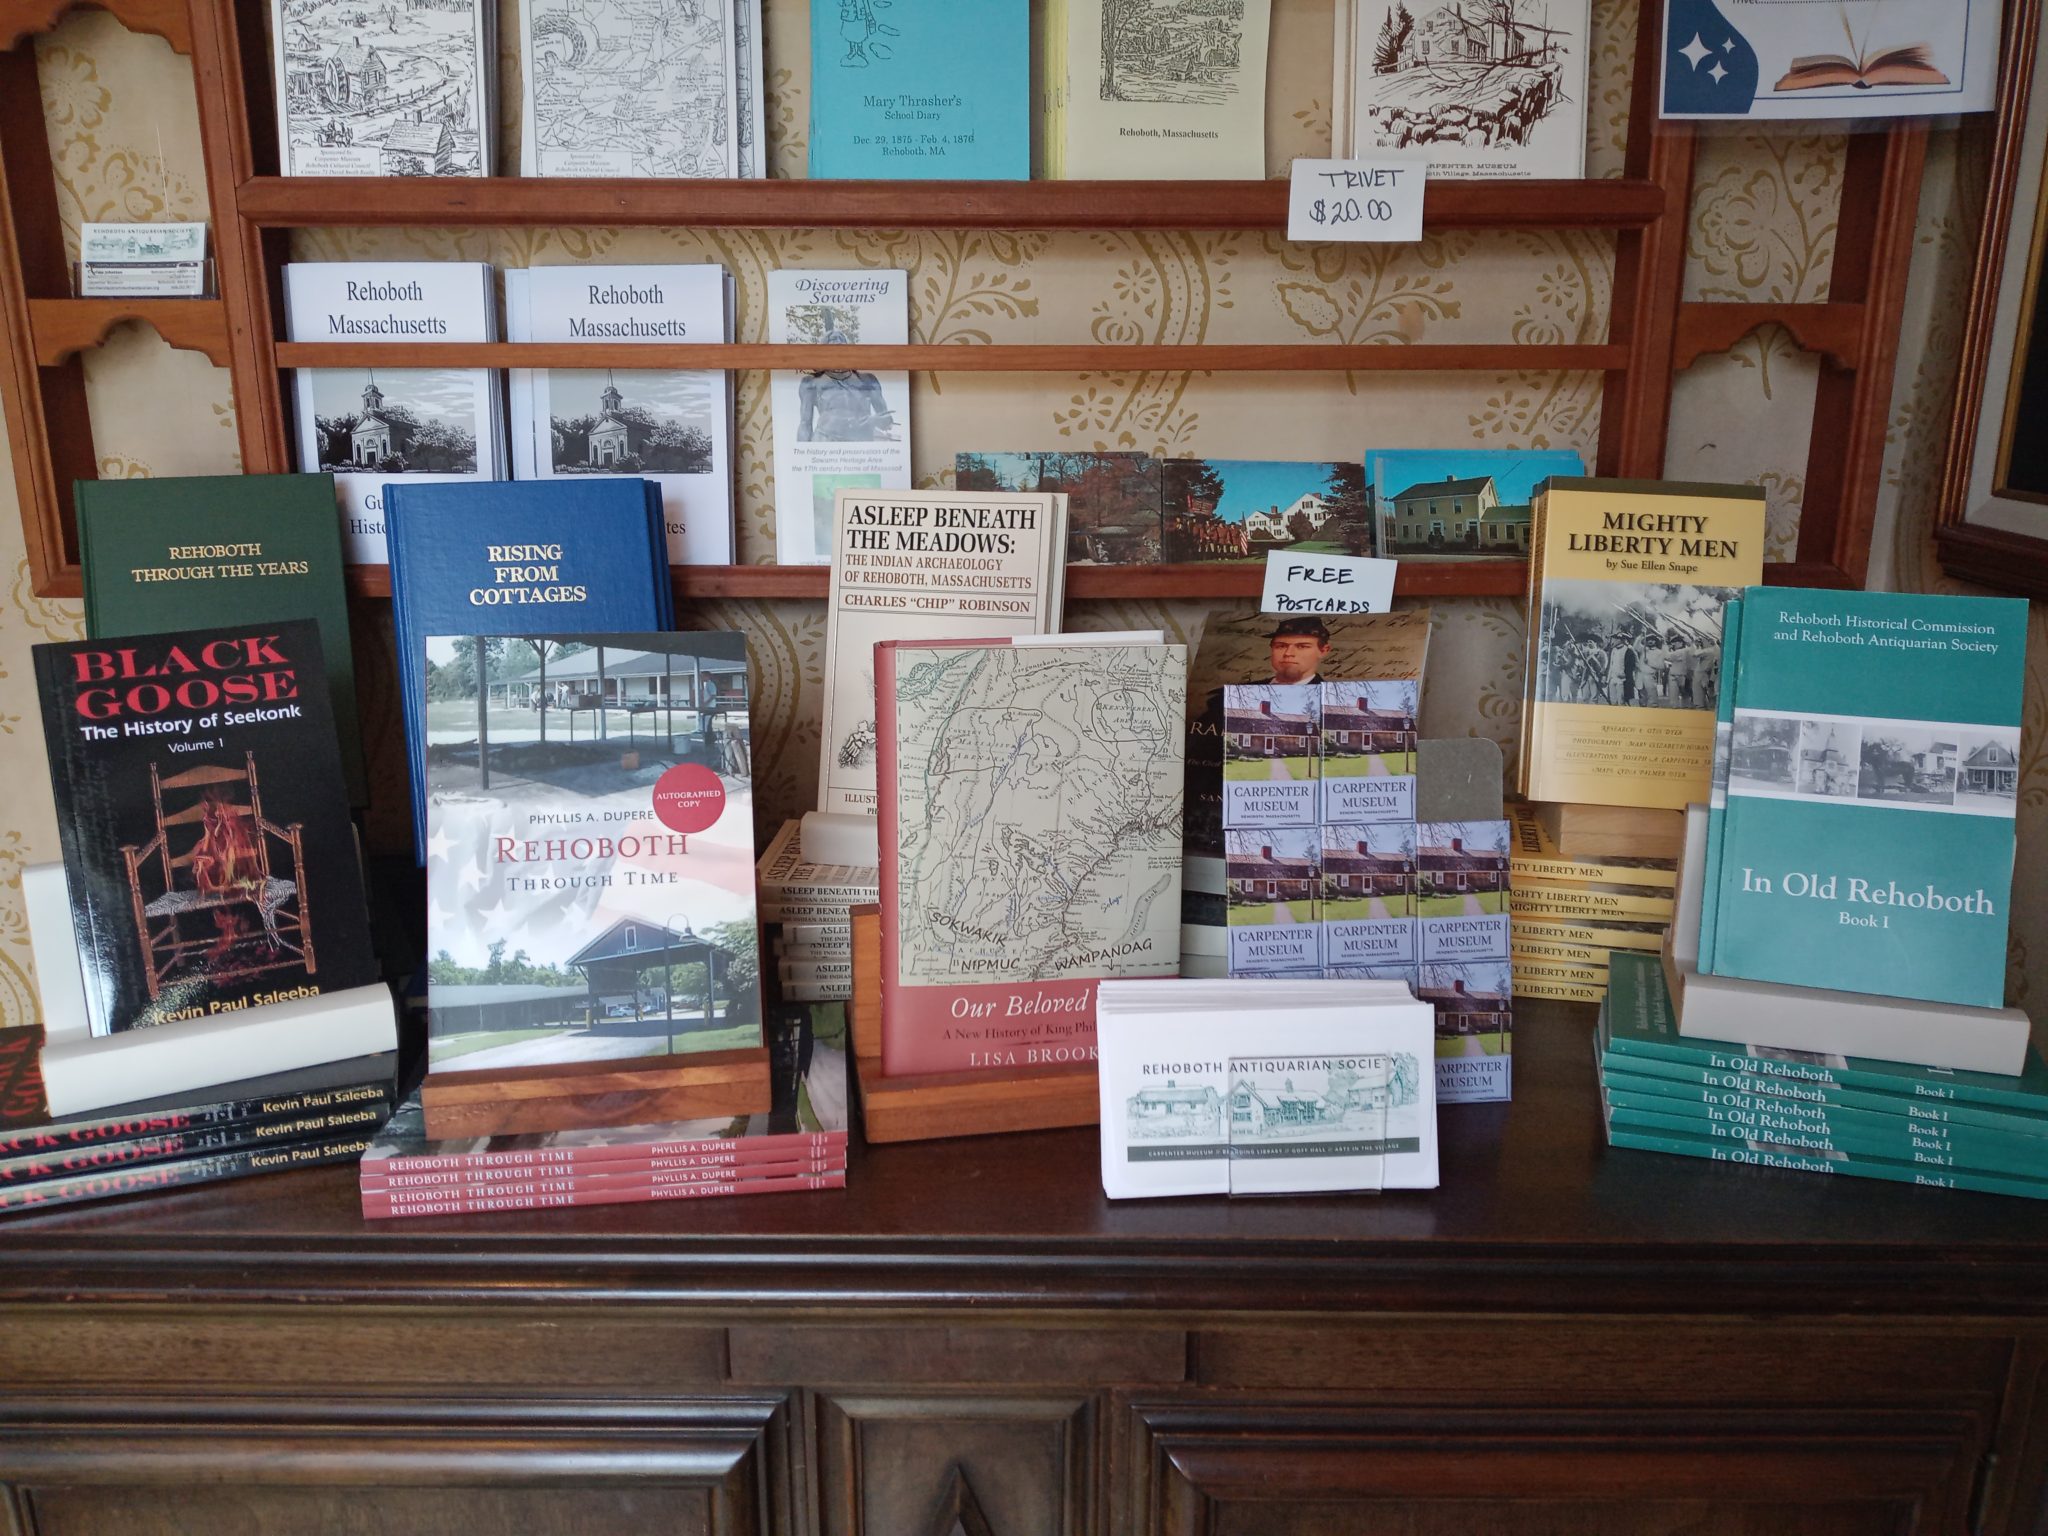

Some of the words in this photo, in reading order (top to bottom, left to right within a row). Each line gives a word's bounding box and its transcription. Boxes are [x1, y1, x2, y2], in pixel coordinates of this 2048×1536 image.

[864, 95, 895, 109] Mary
[899, 94, 962, 106] Thrasher's
[885, 111, 914, 120] School
[917, 111, 941, 120] Diary
[1120, 128, 1160, 138] Rehoboth,
[1162, 129, 1218, 138] Massachusetts
[882, 147, 926, 156] Rehoboth,
[930, 147, 945, 155] MA
[1319, 168, 1404, 188] TRIVET
[1309, 199, 1393, 225] $20.00
[347, 281, 423, 300] Rehoboth
[589, 284, 664, 304] Rehoboth
[795, 278, 889, 294] Discovering
[810, 292, 876, 304] Sowams
[328, 314, 446, 334] Massachusetts
[568, 317, 685, 336] Massachusetts
[848, 506, 928, 527] ASLEEP
[934, 508, 1037, 530] BENEATH
[1603, 512, 1708, 533] MIGHTY
[169, 543, 261, 560] REHOBOTH
[847, 530, 890, 550] THE
[896, 532, 1015, 554] MEADOWS:
[1568, 534, 1671, 555] LIBERTY
[1680, 538, 1738, 558] MEN
[487, 544, 563, 562] RISING
[846, 554, 868, 566] THE
[871, 555, 912, 568] INDIAN
[916, 557, 1003, 570] ARCHAEOLOGY
[132, 565, 214, 582] THROUGH
[218, 564, 253, 578] THE
[257, 561, 308, 576] YEARS
[494, 566, 559, 583] FROM
[1288, 566, 1354, 584] FREE
[1607, 558, 1617, 569] by
[1621, 559, 1638, 569] Sue
[1641, 560, 1665, 571] Ellen
[1668, 562, 1698, 574] Snape
[845, 571, 859, 582] OF
[863, 572, 927, 586] REHOBOTH,
[931, 575, 1032, 589] MASSACHUSETTS
[469, 586, 586, 605] COTTAGES
[845, 594, 907, 608] CHARLES
[958, 600, 1030, 613] ROBINSON
[1276, 594, 1369, 614] POSTCARDS
[1780, 612, 1840, 626] Rehoboth
[1846, 615, 1907, 630] Historical
[1912, 618, 1995, 634] Commission
[1774, 629, 1798, 640] and
[1802, 630, 1864, 645] Rehoboth
[1868, 634, 1947, 650] Antiquarian
[1952, 638, 1998, 654] Society
[72, 635, 288, 683] BLACK
[76, 670, 298, 719] GOOSE
[80, 726, 118, 741] The
[124, 718, 192, 736] History
[200, 714, 218, 728] of
[224, 704, 302, 725] Seekonk
[168, 739, 214, 753] Volume
[219, 738, 224, 748] 1
[657, 790, 721, 800] AUTOGRAPHED
[1235, 787, 1309, 797] CARPENTER
[1333, 782, 1406, 793] CARPENTER
[1244, 801, 1299, 812] MUSEUM
[1342, 797, 1396, 807] MUSEUM
[529, 813, 582, 824] PHYLLIS
[586, 812, 598, 822] A.
[604, 810, 654, 821] DUPERE
[495, 834, 689, 864] REHOBOTH
[1533, 864, 1576, 874] LIBERTY
[1580, 868, 1603, 877] MEN
[507, 875, 612, 891] THROUGH
[624, 872, 678, 885] TIME
[1547, 892, 1591, 903] LIBERTY
[1594, 896, 1618, 906] MEN
[1742, 868, 1772, 894] In
[1782, 872, 1837, 900] Old
[1848, 878, 1995, 916] Rehoboth
[930, 912, 1006, 947] SOKWAKIK
[1840, 912, 1878, 928] Book
[1334, 924, 1407, 937] CARPENTER
[1055, 938, 1152, 971] WAMPANOAG
[1344, 939, 1398, 951] MUSEUM
[961, 958, 1021, 971] NIPMUC
[154, 1006, 204, 1025] Kevin
[210, 998, 249, 1014] Paul
[253, 985, 320, 1007] Saleeba
[951, 998, 996, 1018] Our
[1005, 988, 1089, 1017] Beloved
[943, 1031, 951, 1040] A
[956, 1029, 981, 1039] New
[986, 1025, 1027, 1039] History
[1030, 1024, 1042, 1036] of
[1046, 1023, 1072, 1036] King
[971, 1052, 1016, 1066] LISA
[1143, 1063, 1222, 1074] REHOBOTH
[1229, 1060, 1331, 1072] ANTIQUARIAN
[1440, 1076, 1492, 1087] MUSEUM
[1710, 1055, 1725, 1067] In
[1731, 1058, 1757, 1072] Old
[1763, 1062, 1833, 1082] Rehoboth
[1915, 1085, 1946, 1098] Book
[263, 1101, 299, 1112] Kevin
[304, 1095, 331, 1107] Paul
[335, 1088, 383, 1103] Saleeba
[69, 1114, 190, 1140] GOOSE
[256, 1123, 292, 1137] Kevin
[296, 1118, 323, 1131] Paul
[328, 1111, 376, 1126] Saleeba
[390, 1158, 459, 1171] REHOBOTH
[466, 1154, 533, 1166] THROUGH
[540, 1152, 574, 1161] TIME
[652, 1145, 688, 1154] PHYLLIS
[690, 1143, 699, 1152] A.
[702, 1142, 736, 1151] DUPERE
[389, 1173, 458, 1187] REHOBOTH
[466, 1168, 532, 1181] THROUGH
[540, 1166, 574, 1176] TIME
[651, 1158, 688, 1168] PHYLLIS
[689, 1157, 699, 1165] A.
[701, 1155, 735, 1165] DUPERE
